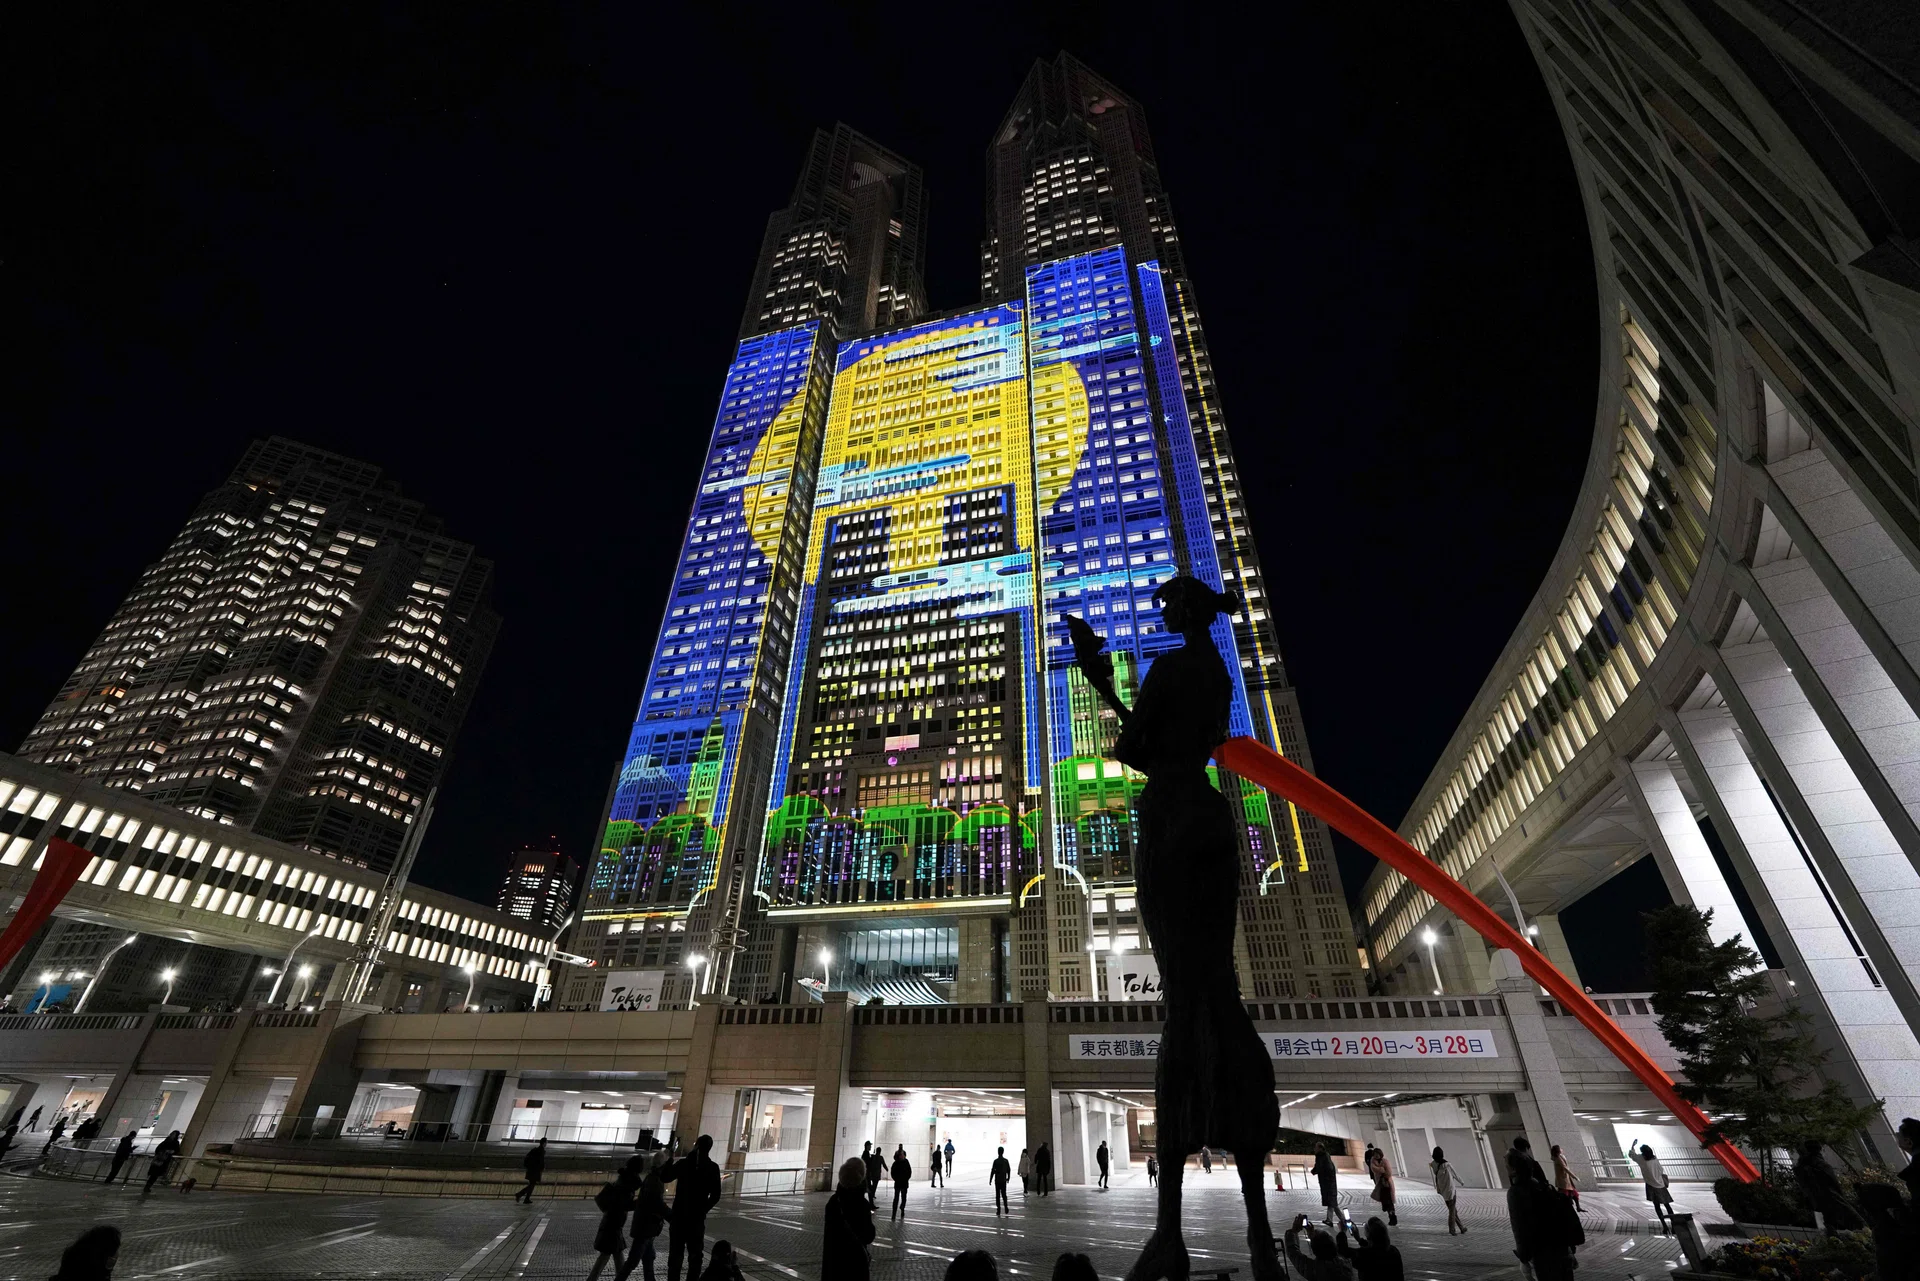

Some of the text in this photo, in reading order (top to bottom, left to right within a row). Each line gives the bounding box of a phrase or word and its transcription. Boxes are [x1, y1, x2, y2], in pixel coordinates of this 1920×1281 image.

[611, 986, 652, 1010] Tokyo
[1080, 1040, 1160, 1056] 東京都議会
